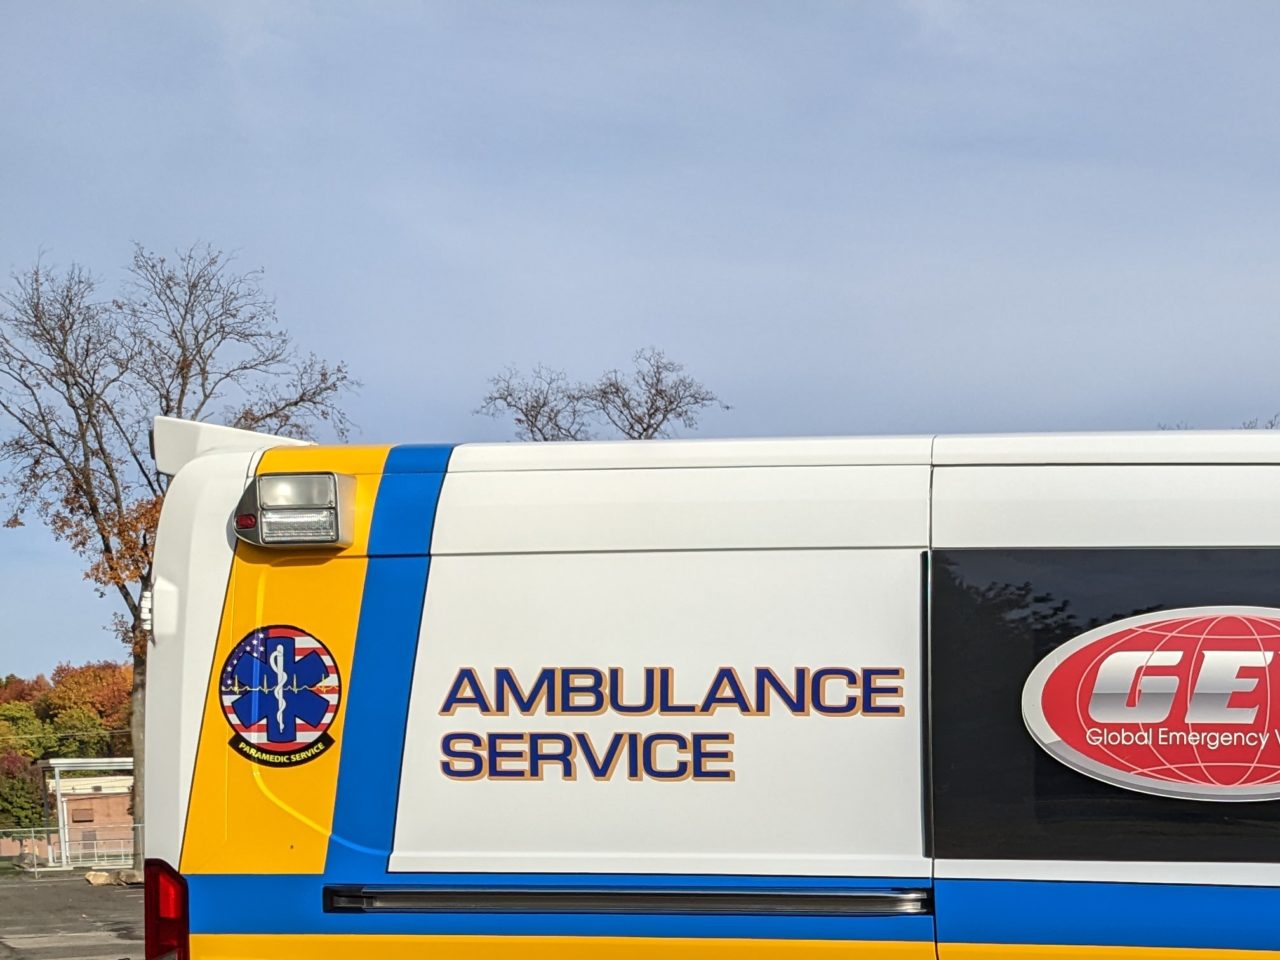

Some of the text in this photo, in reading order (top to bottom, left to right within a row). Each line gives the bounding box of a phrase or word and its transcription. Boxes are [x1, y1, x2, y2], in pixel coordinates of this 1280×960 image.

[439, 666, 905, 717] AMBULANCE
[239, 742, 325, 763] PARAMEDIC SERVICE
[439, 731, 736, 782] SERVICE
[1086, 728, 1152, 746] Global
[1159, 728, 1270, 751] Emergency
